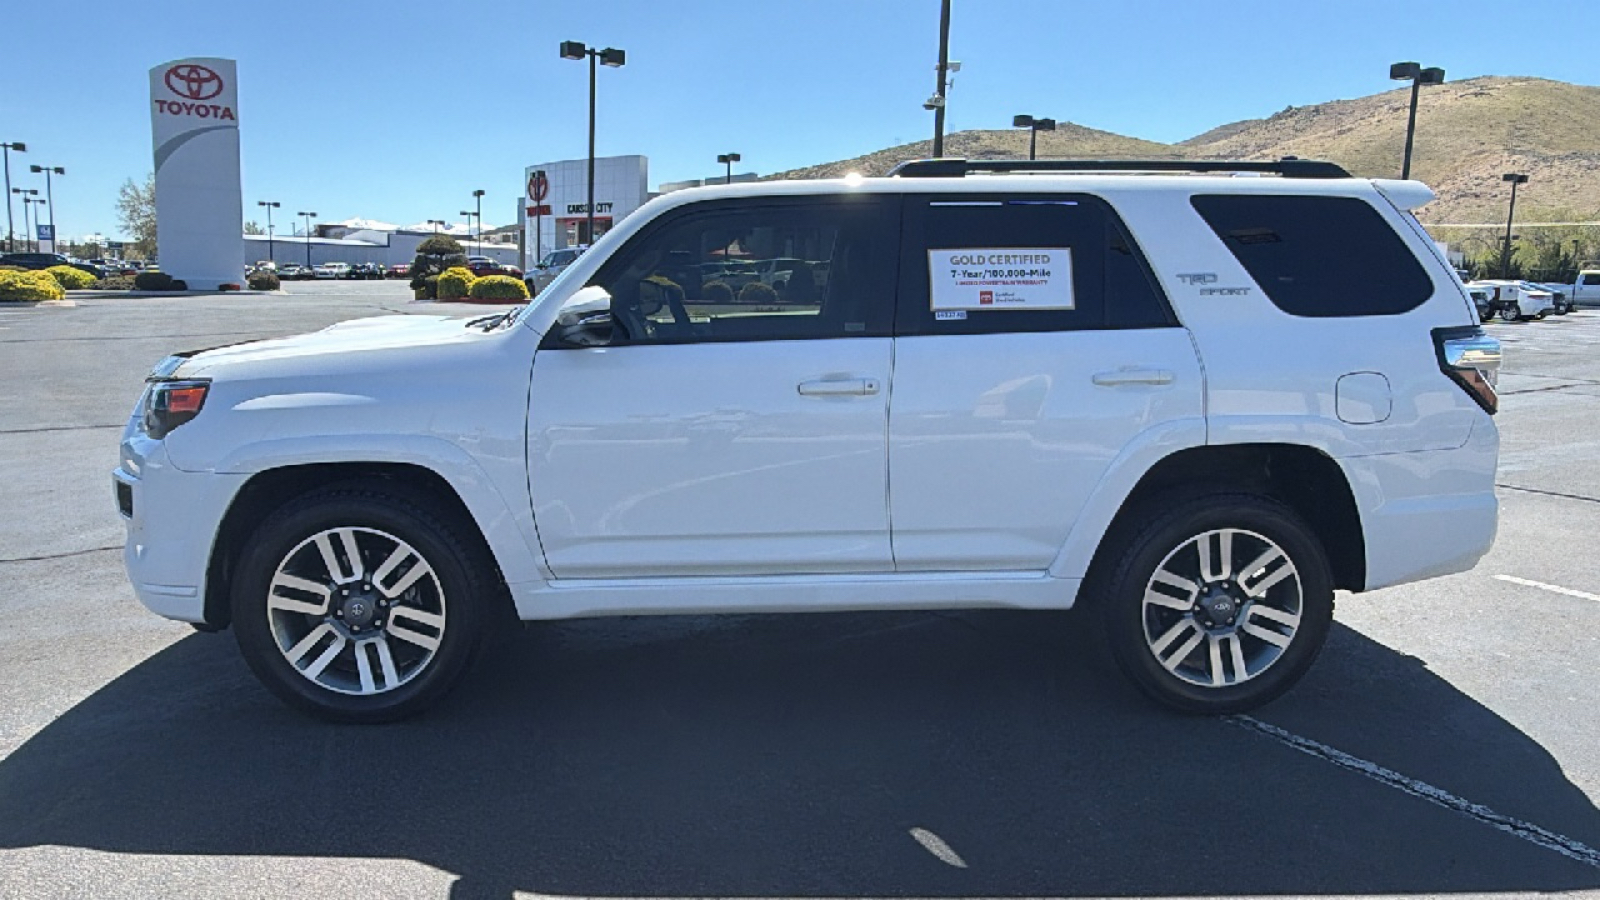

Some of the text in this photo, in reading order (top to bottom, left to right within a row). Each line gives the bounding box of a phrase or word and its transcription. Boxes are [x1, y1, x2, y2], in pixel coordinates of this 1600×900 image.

[155, 99, 235, 120] TOYOTA
[596, 202, 613, 213] CITY
[950, 254, 1051, 265] GOLD CERTIFIED
[1176, 273, 1218, 285] TRD
[1200, 287, 1251, 296] SPORT
